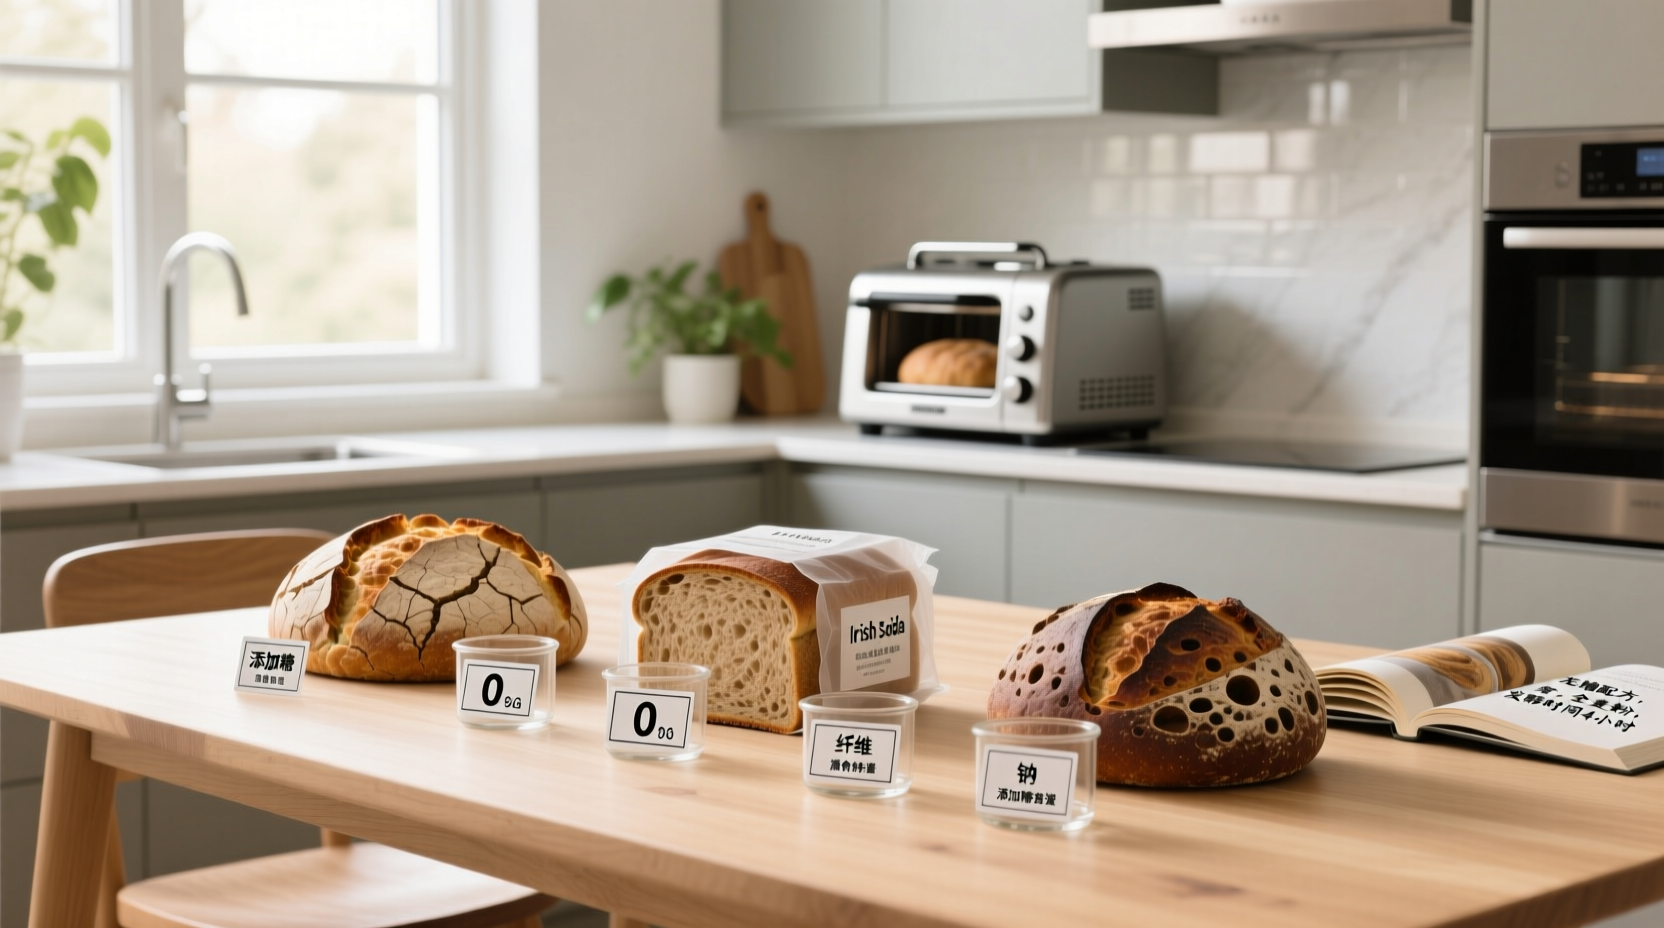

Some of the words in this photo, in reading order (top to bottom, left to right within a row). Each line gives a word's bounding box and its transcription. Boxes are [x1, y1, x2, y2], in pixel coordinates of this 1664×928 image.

[850, 620, 877, 644] Irish
[249, 650, 295, 672] 添加糖
[481, 672, 504, 707] 0
[633, 701, 657, 737] 0
[834, 733, 873, 756] 纤维
